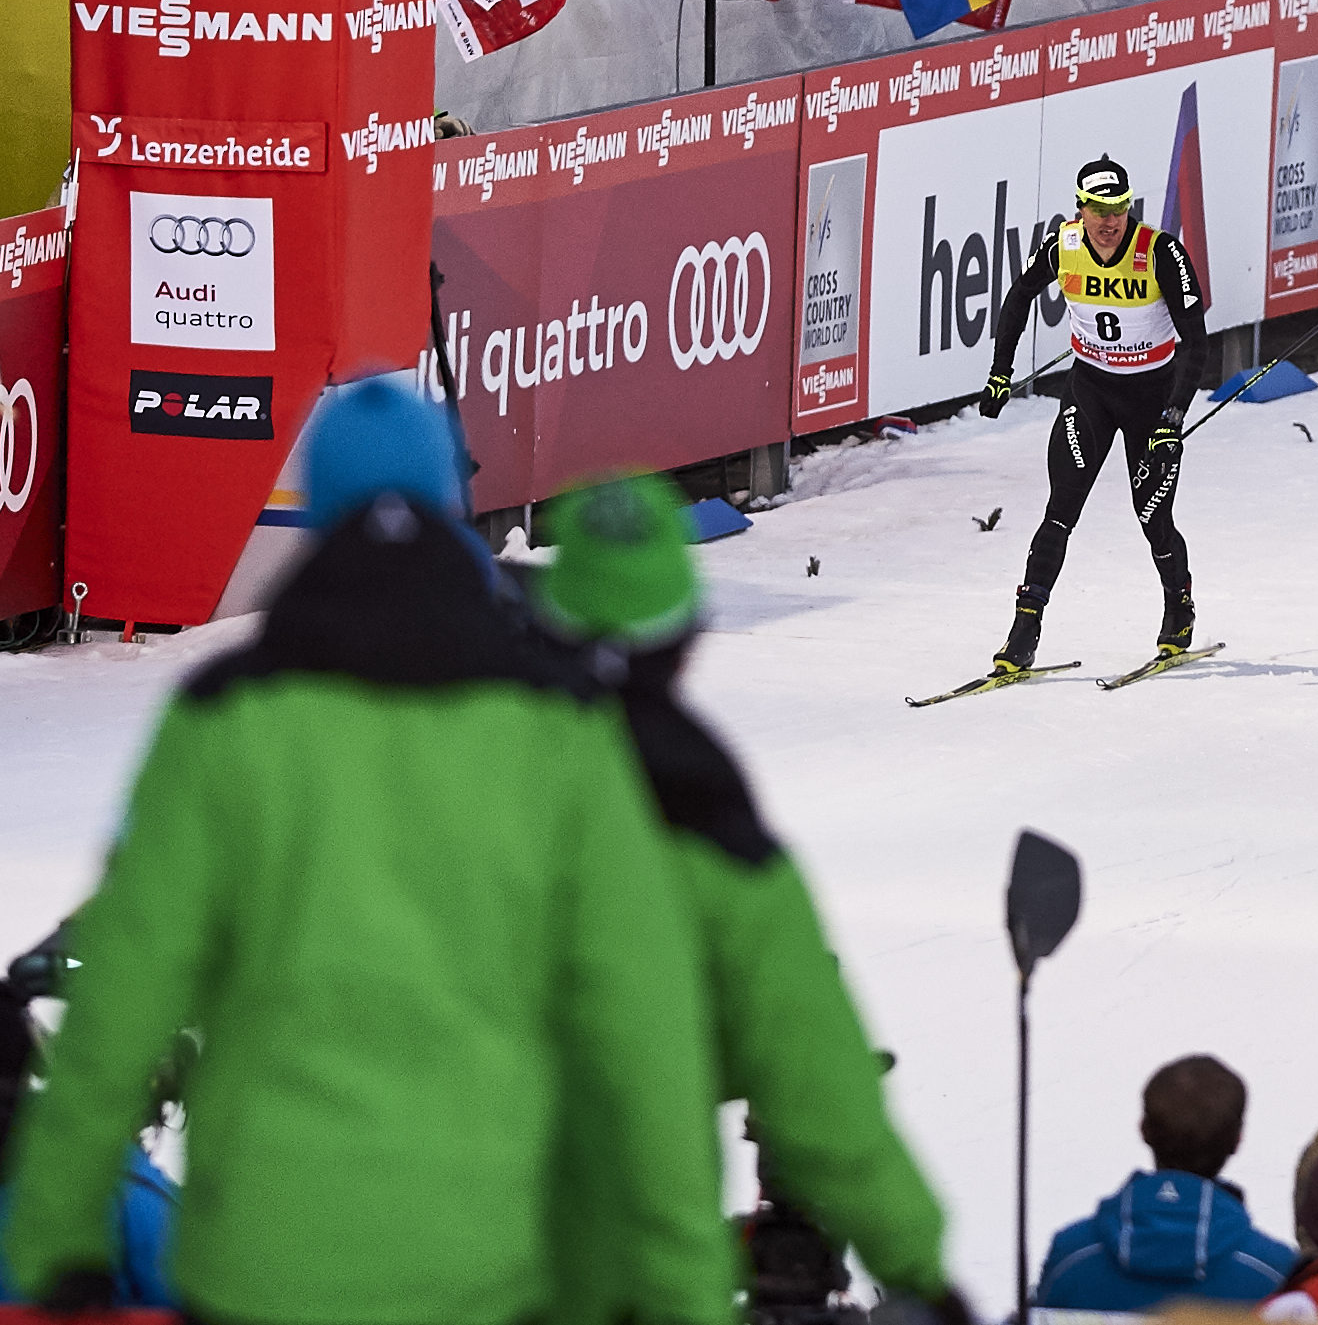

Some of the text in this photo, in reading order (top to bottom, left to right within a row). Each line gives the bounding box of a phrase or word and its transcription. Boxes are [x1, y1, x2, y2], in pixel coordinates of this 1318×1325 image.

[1049, 28, 1117, 82] VIESSMANN
[1126, 12, 1195, 66] VIESSMANN
[890, 60, 961, 116] VIESSMANN
[970, 44, 1039, 99] VIESSMANN
[723, 92, 796, 149] VIESSMANN
[806, 76, 879, 132] VIESSMANN
[131, 133, 311, 168] Lenzerheide
[341, 112, 436, 175] VIESSMANN
[549, 126, 627, 184] VIESSMANN
[637, 109, 712, 166] VIESSMANN
[458, 142, 538, 202] VIESSMANN
[1276, 183, 1317, 214] COUNTRY
[1277, 161, 1305, 187] CROSS
[0, 226, 66, 289] IESSMANN
[807, 270, 838, 299] CROSS
[1168, 240, 1191, 293] helvetia
[154, 280, 217, 303] Audi
[806, 294, 852, 326] COUNTRY
[1085, 276, 1148, 300] BKW
[154, 309, 254, 330] quattro
[804, 322, 848, 351] WORLD CUP
[1095, 312, 1122, 342] 8
[481, 294, 648, 416] quattro
[1081, 346, 1148, 364] VIESSMANN
[802, 364, 854, 404] VIESSMANN
[1065, 415, 1086, 469] swisscom
[1139, 462, 1179, 524] RAIFFEISEN
